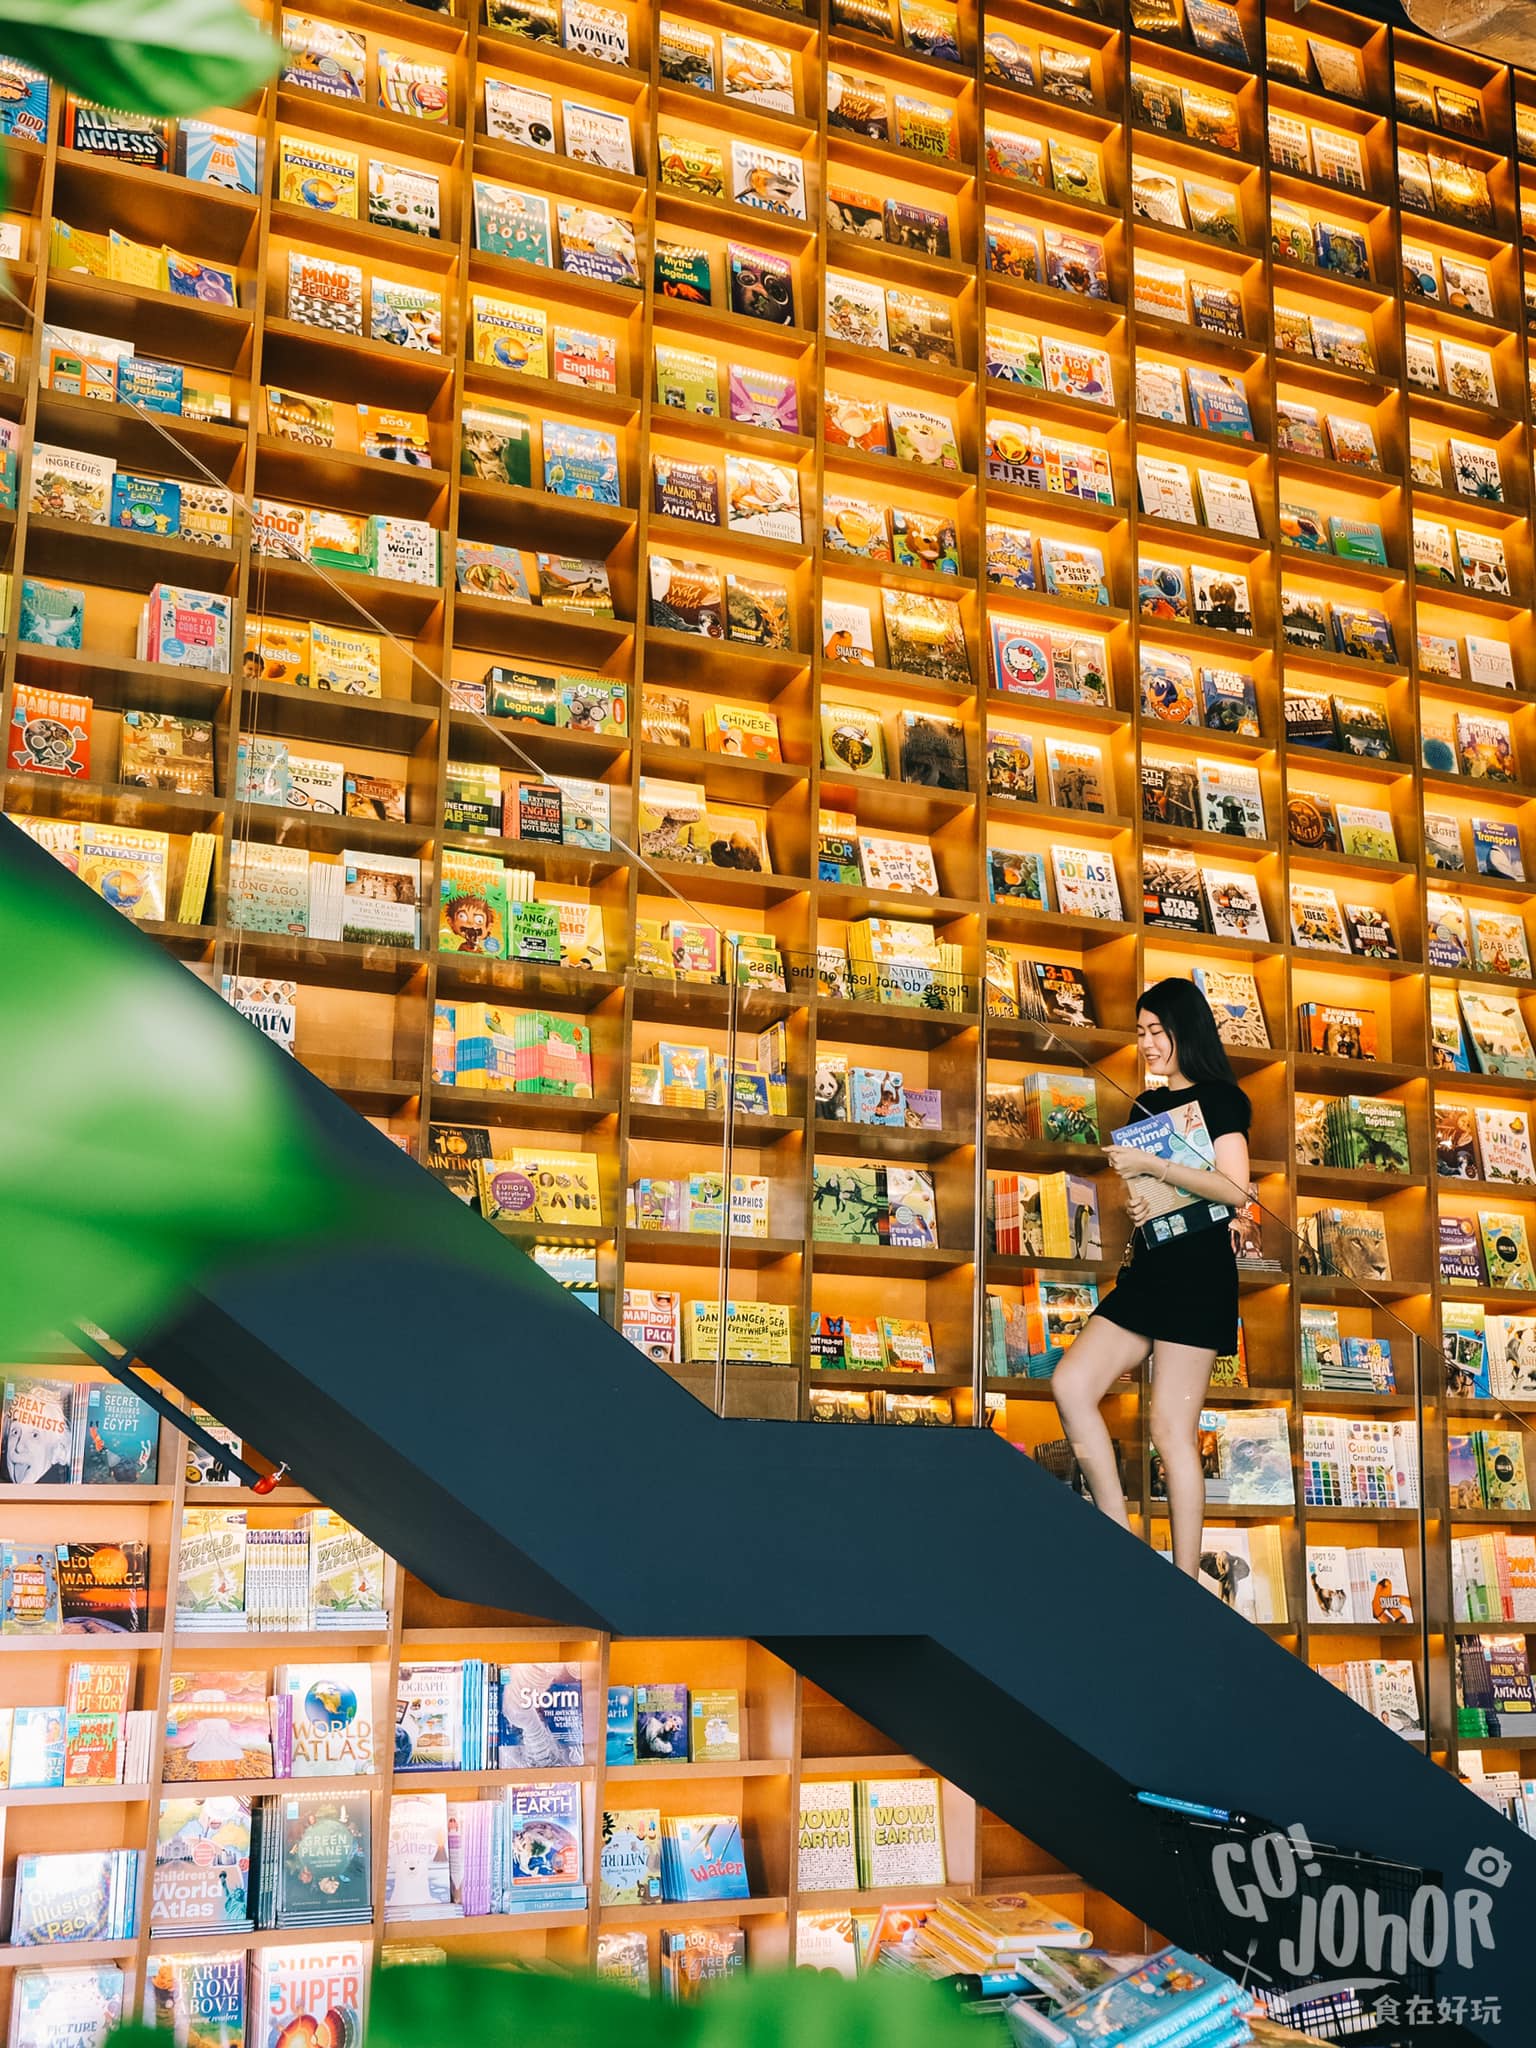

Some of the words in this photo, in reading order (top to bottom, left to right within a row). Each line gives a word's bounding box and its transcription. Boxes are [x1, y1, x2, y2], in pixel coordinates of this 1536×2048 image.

[569, 22, 626, 51] WOMEN
[286, 72, 354, 99] Animal
[18, 112, 44, 132] ODD
[78, 130, 158, 155] ACCESS
[911, 131, 944, 153] FACTS
[211, 151, 235, 169] BIG
[286, 155, 354, 178] FANTASTIC
[485, 221, 542, 248] BODY
[565, 251, 627, 276] Animal
[664, 255, 694, 270] Myths
[302, 266, 350, 289] MIND
[659, 265, 699, 284] Legends
[302, 281, 350, 302] BENDERS
[384, 292, 425, 310] Earth
[477, 312, 543, 336] FANTASTIC
[562, 357, 611, 381] English
[1067, 358, 1089, 372] 100
[1209, 398, 1244, 417] TOOLBOX
[44, 456, 103, 478] INGREEDIES
[1456, 451, 1498, 471] Science
[989, 461, 1041, 485] FIRE
[662, 485, 697, 501] AMAZING
[662, 503, 717, 524] ANIMALS
[695, 499, 713, 513] WILD
[387, 542, 423, 557] World
[1414, 538, 1449, 559] UNIOR
[322, 632, 372, 654] Barron's
[836, 643, 864, 660] SNAKES
[577, 683, 609, 699] Quiz
[504, 700, 545, 715] Legends
[1284, 699, 1318, 717] STAR
[722, 712, 773, 733] CHINESE
[1286, 708, 1325, 725] WARS
[293, 775, 310, 784] TO
[313, 778, 333, 788] ME
[444, 801, 483, 814] INECRAFT
[521, 804, 560, 819] ENGLISH
[521, 823, 560, 835] NOTEBOOK
[1476, 831, 1517, 847] Transport
[86, 844, 163, 864] FANTASTIC
[884, 860, 912, 873] Fairy
[886, 869, 916, 882] Tales
[231, 878, 269, 892] LONG
[271, 883, 300, 897] AGO
[456, 882, 487, 896] FACTS
[1161, 897, 1188, 912] STAR
[516, 912, 554, 927] DANGER
[1162, 906, 1200, 921] WARS
[1303, 909, 1328, 923] IDEAS
[514, 925, 559, 938] EVERYWHERE
[560, 922, 586, 936] BIG
[1428, 948, 1461, 961] nimal
[1483, 940, 1521, 954] BABIES
[890, 966, 932, 982] NATURE
[1045, 965, 1074, 983] 3-D
[1321, 1013, 1363, 1028] SAFARI
[1357, 1104, 1402, 1119] Amphibians
[1115, 1119, 1159, 1141] Children's
[1365, 1116, 1396, 1128] Reptiles
[1120, 1123, 1173, 1148] Animal
[1484, 1129, 1528, 1152] JUNIOR
[732, 1195, 764, 1210] RAPHICS
[732, 1213, 752, 1226] KIDS
[1339, 1225, 1385, 1241] Mammals
[1439, 1263, 1481, 1278] ANIMALS
[624, 1311, 648, 1325] MAN
[650, 1312, 675, 1326] BODY
[646, 1327, 674, 1342] PACK
[728, 1325, 769, 1338] EVERYWHERE
[11, 1396, 47, 1417] GREAT
[104, 1394, 141, 1408] SECRET
[103, 1405, 141, 1416] TREASURES
[7, 1408, 66, 1434] SCIENTISTS
[102, 1417, 140, 1433] EGYPT
[1348, 1441, 1389, 1456] Curious
[1352, 1453, 1387, 1464] Creatures
[178, 1534, 235, 1561] WORLD
[316, 1531, 372, 1560] WORLD
[23, 1573, 45, 1586] Feed
[1378, 1596, 1402, 1610] SNAKES
[1490, 1663, 1516, 1676] AMAZING
[79, 1676, 126, 1694] DEADLY
[1493, 1685, 1533, 1700] ANIMALS
[77, 1694, 125, 1711] HISTORY
[520, 1687, 579, 1710] Storm
[608, 1708, 630, 1719] arth
[291, 1719, 372, 1741] WORLD
[293, 1739, 372, 1762] ATLAS
[515, 1796, 573, 1815] EARTH
[875, 1806, 935, 1826] WOW!
[304, 1834, 348, 1847] GREEN
[799, 1831, 851, 1849] ARTH
[875, 1826, 936, 1846] EARTH
[301, 1844, 351, 1858] PLANET
[153, 1870, 217, 1885] Children's
[152, 1880, 225, 1901] World
[151, 1900, 216, 1921] Atlas
[46, 1911, 99, 1940] Pack
[685, 1934, 707, 1948] 100
[680, 1955, 743, 1969] EXTREME
[178, 1962, 241, 1982] EARTH
[688, 1967, 735, 1981] EARTH
[178, 1979, 241, 2000] FROM
[271, 1977, 359, 2016] SUPER
[176, 1996, 240, 2016] ABOVE
